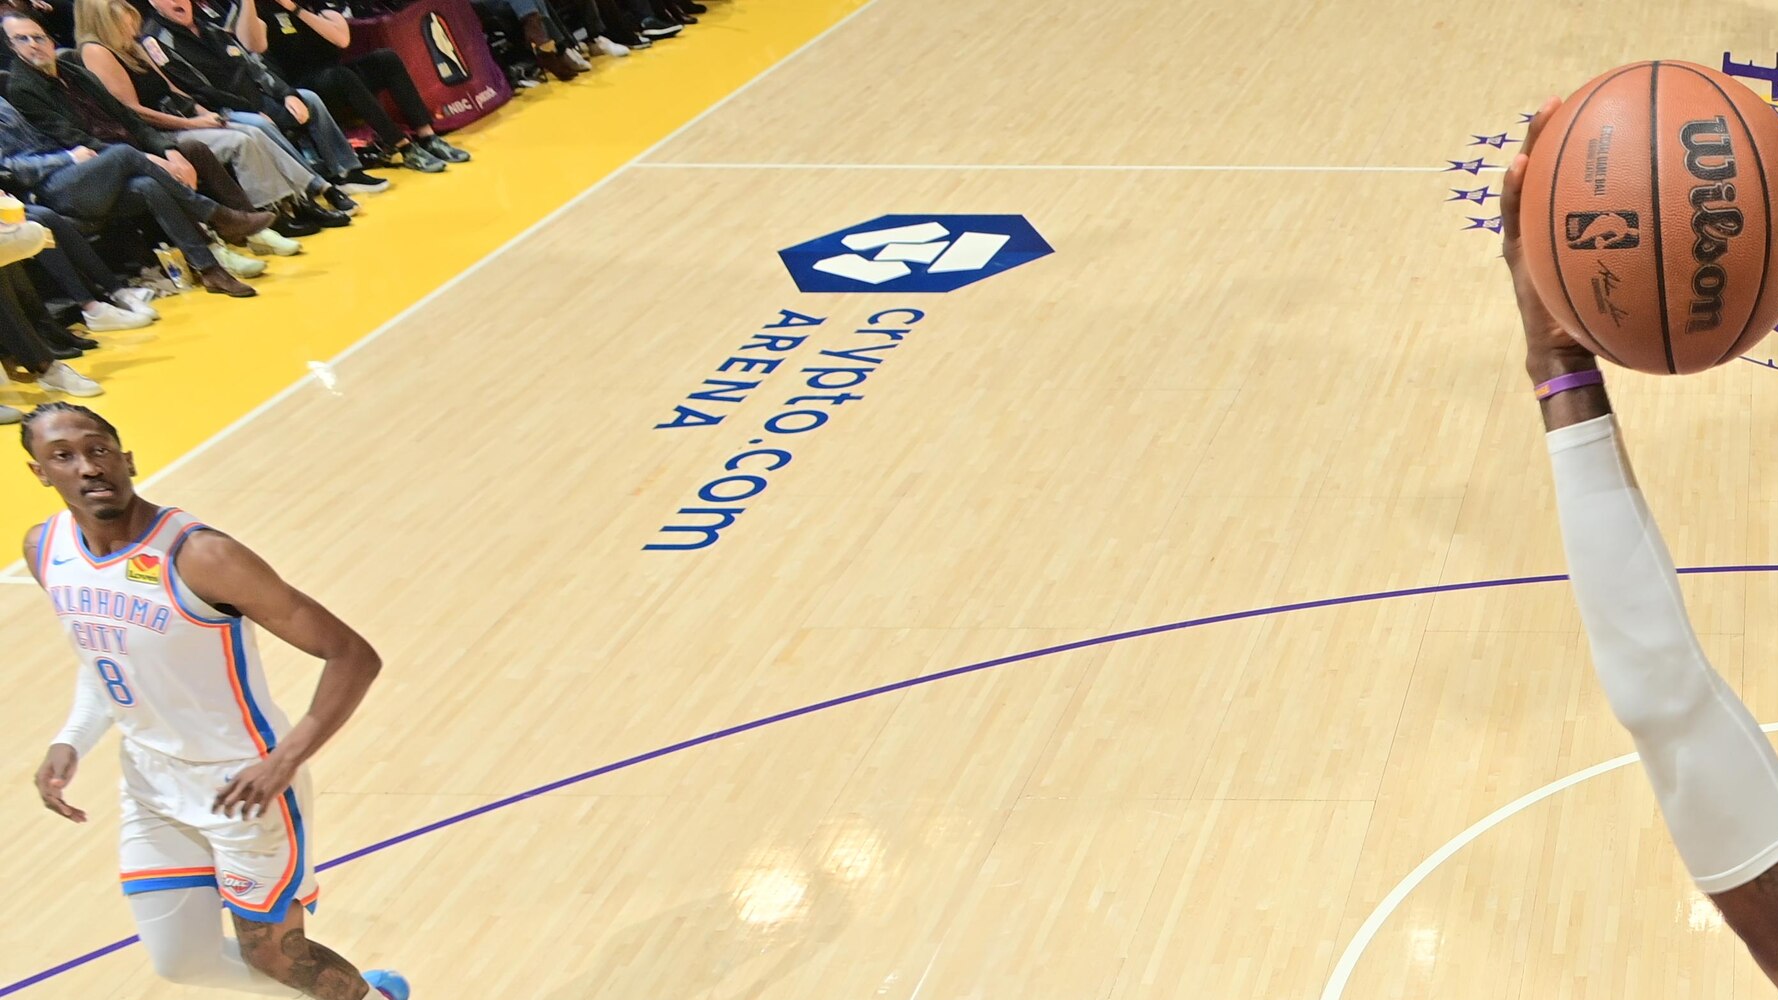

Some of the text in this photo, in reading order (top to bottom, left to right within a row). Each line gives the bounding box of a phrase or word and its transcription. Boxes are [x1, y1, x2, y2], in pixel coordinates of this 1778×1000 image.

[1679, 114, 1745, 334] Wilson
[653, 308, 828, 430] ARENA
[641, 307, 925, 551] crypto.com
[50, 585, 173, 635] KLAHOMA
[72, 620, 129, 656] CITY
[95, 656, 138, 708] 8
